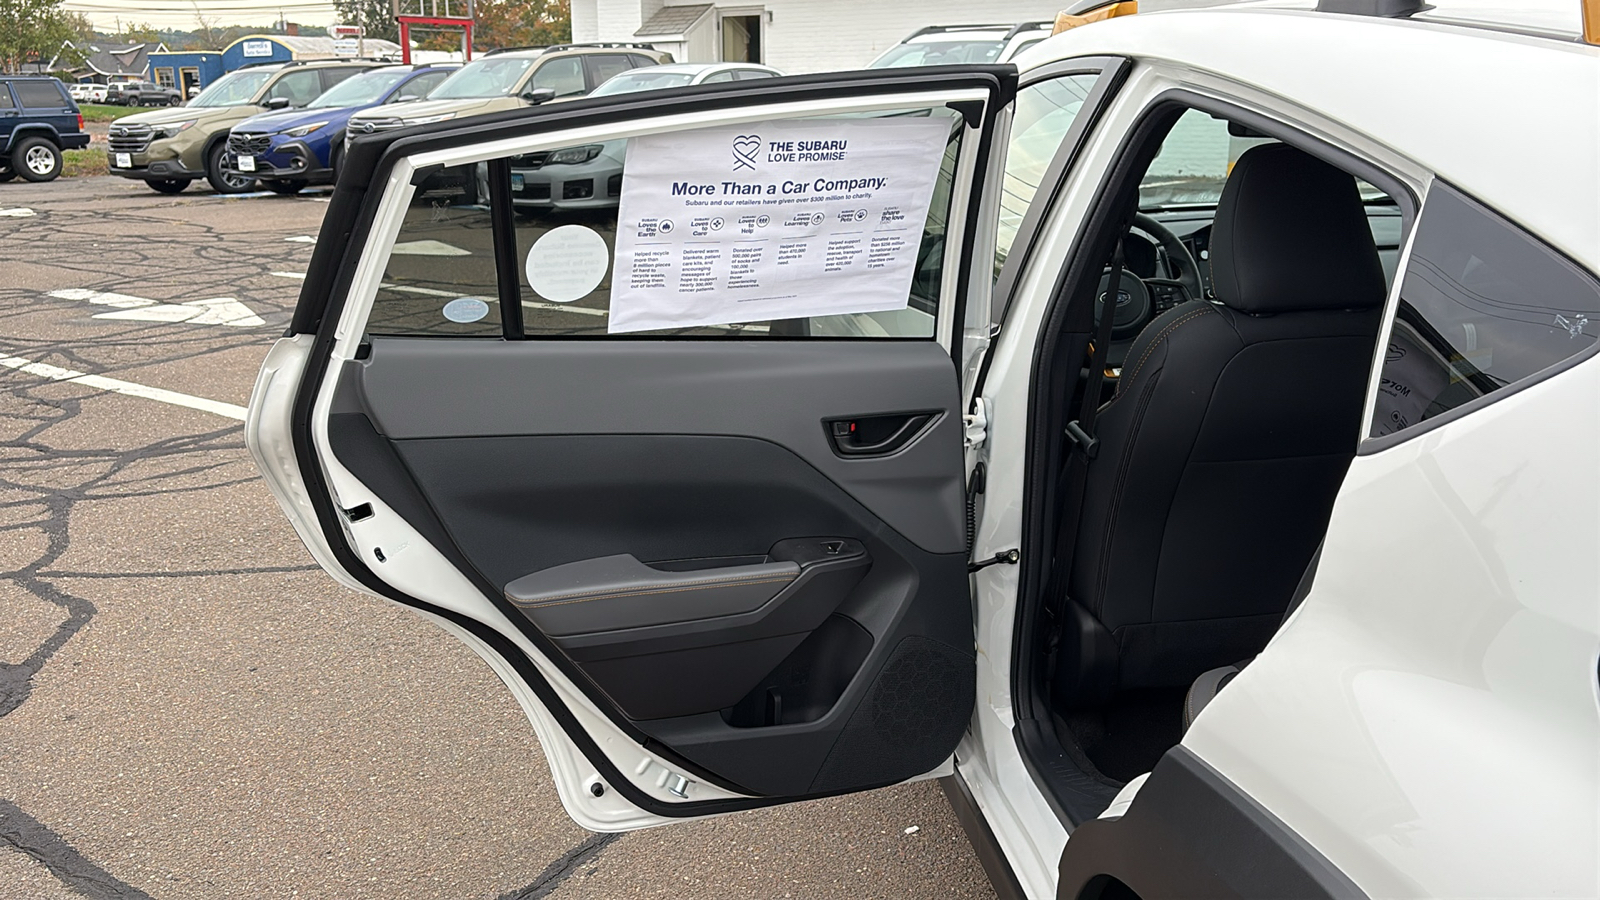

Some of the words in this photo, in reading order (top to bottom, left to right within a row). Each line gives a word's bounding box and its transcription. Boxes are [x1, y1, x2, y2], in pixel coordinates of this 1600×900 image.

[769, 142, 794, 152] THE
[797, 140, 848, 152] SUBARU
[768, 153, 796, 162] LOVE
[798, 152, 846, 162] PROMISE
[672, 182, 716, 196] More
[721, 182, 762, 195] Than
[766, 184, 776, 195] a
[782, 180, 810, 194] Car
[814, 178, 886, 192] Company.
